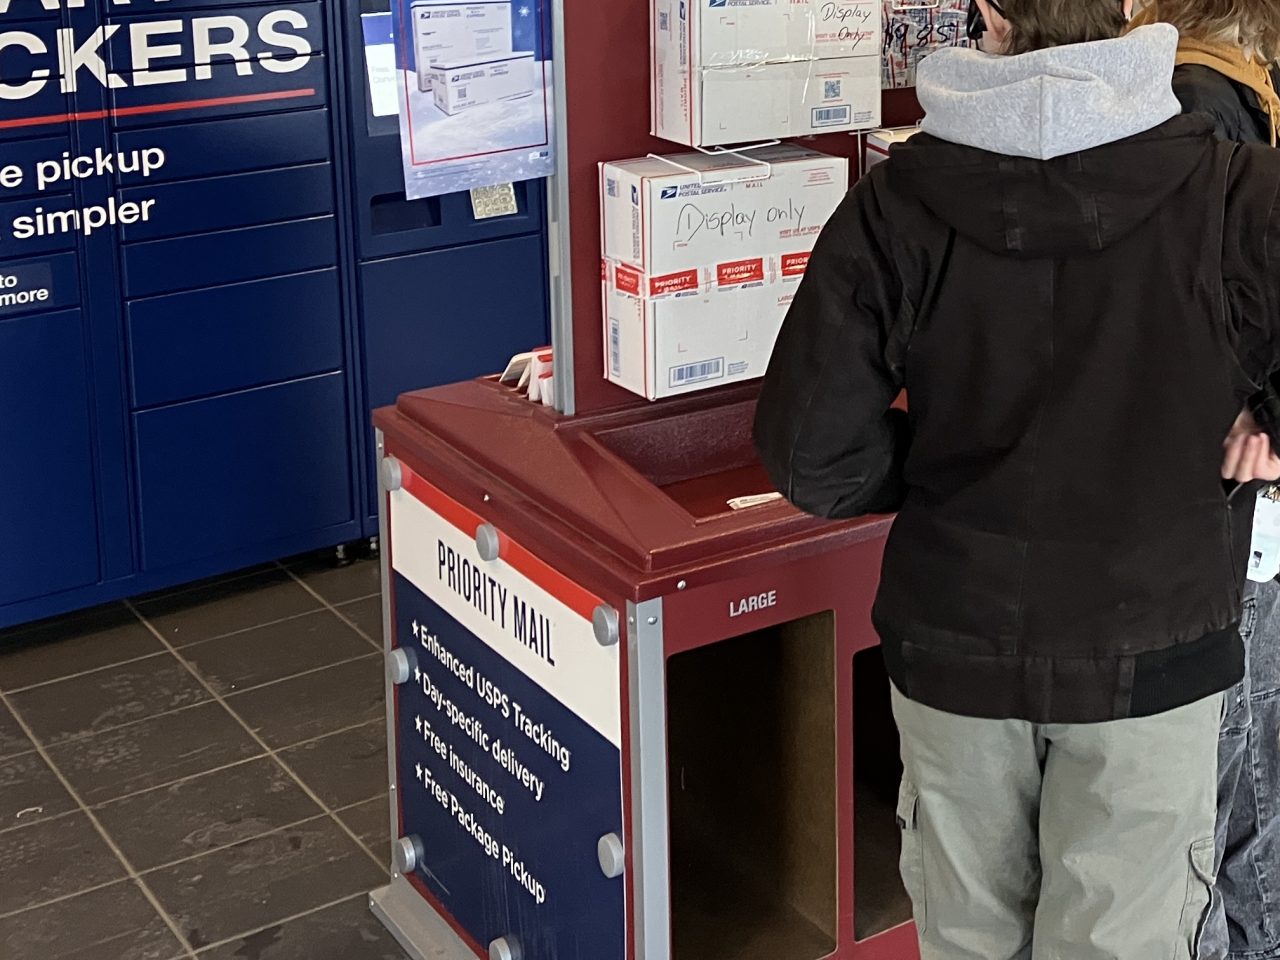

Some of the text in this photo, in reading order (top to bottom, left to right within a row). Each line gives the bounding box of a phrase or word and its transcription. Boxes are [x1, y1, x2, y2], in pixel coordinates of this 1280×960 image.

[820, 2, 872, 24] Display
[0, 9, 312, 101] CKERS
[838, 26, 865, 50] Only
[36, 146, 166, 190] pickup
[12, 196, 156, 240] simpler
[676, 202, 756, 241] Display
[766, 198, 805, 232] only
[0, 274, 18, 288] to
[654, 275, 692, 288] PRIORITY
[722, 264, 756, 275] PRIORITY
[0, 288, 48, 306] more
[778, 294, 794, 302] LARG
[438, 539, 555, 667] PRIORITY MAIL
[729, 590, 777, 618] LARGE
[420, 624, 570, 773] Enhanced USPS Tracking
[423, 672, 544, 802] Day-specific delivery
[424, 720, 504, 816] Free insurance
[424, 766, 546, 905] Free Package Pickup
